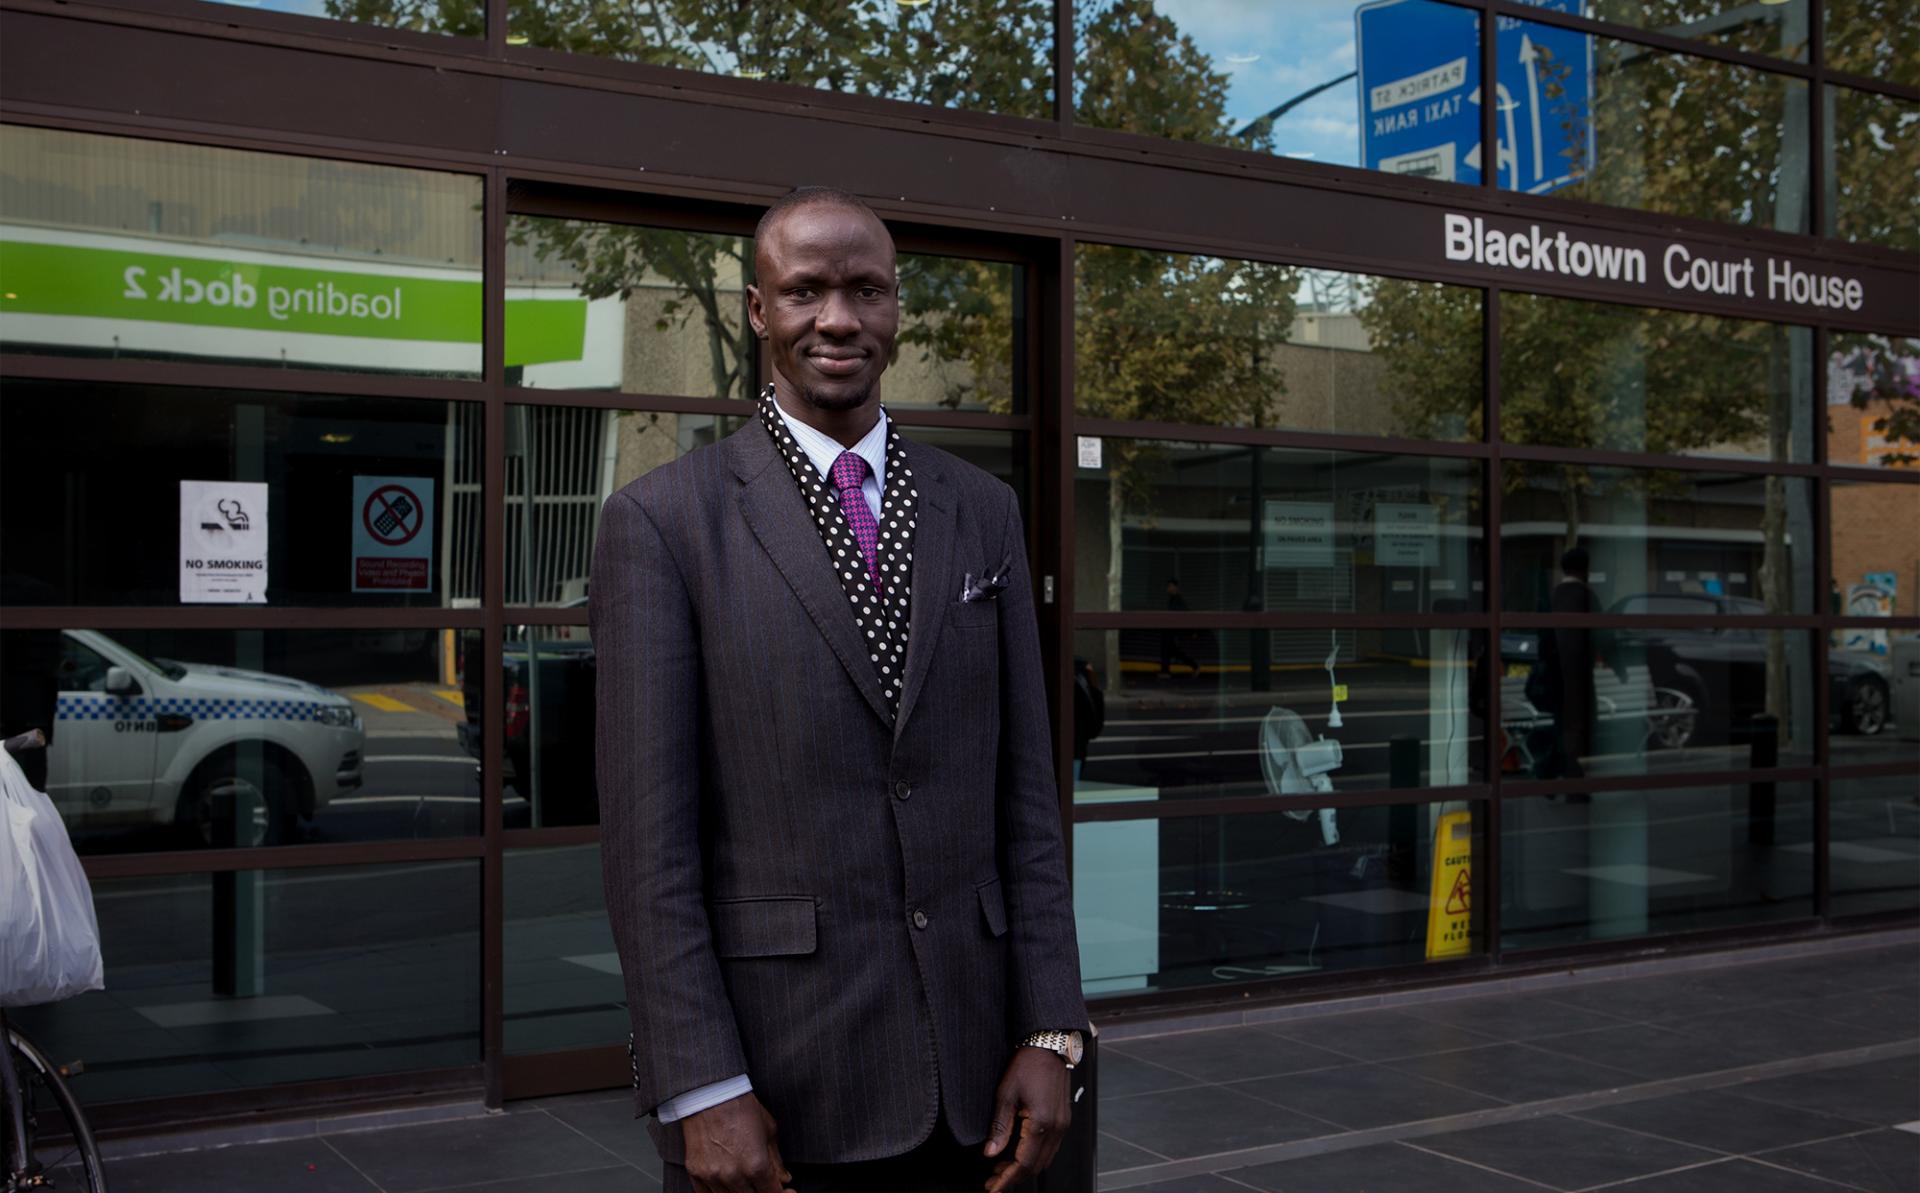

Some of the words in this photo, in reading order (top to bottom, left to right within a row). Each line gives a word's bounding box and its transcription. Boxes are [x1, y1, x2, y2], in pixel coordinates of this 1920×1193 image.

[1444, 213, 1646, 283] Blacktown
[1664, 244, 1754, 298] Court
[1768, 258, 1863, 310] House
[186, 559, 204, 569] NO
[207, 560, 263, 570] SMOKING
[1444, 855, 1471, 867] CAUTI
[1444, 929, 1471, 942] FLOO
